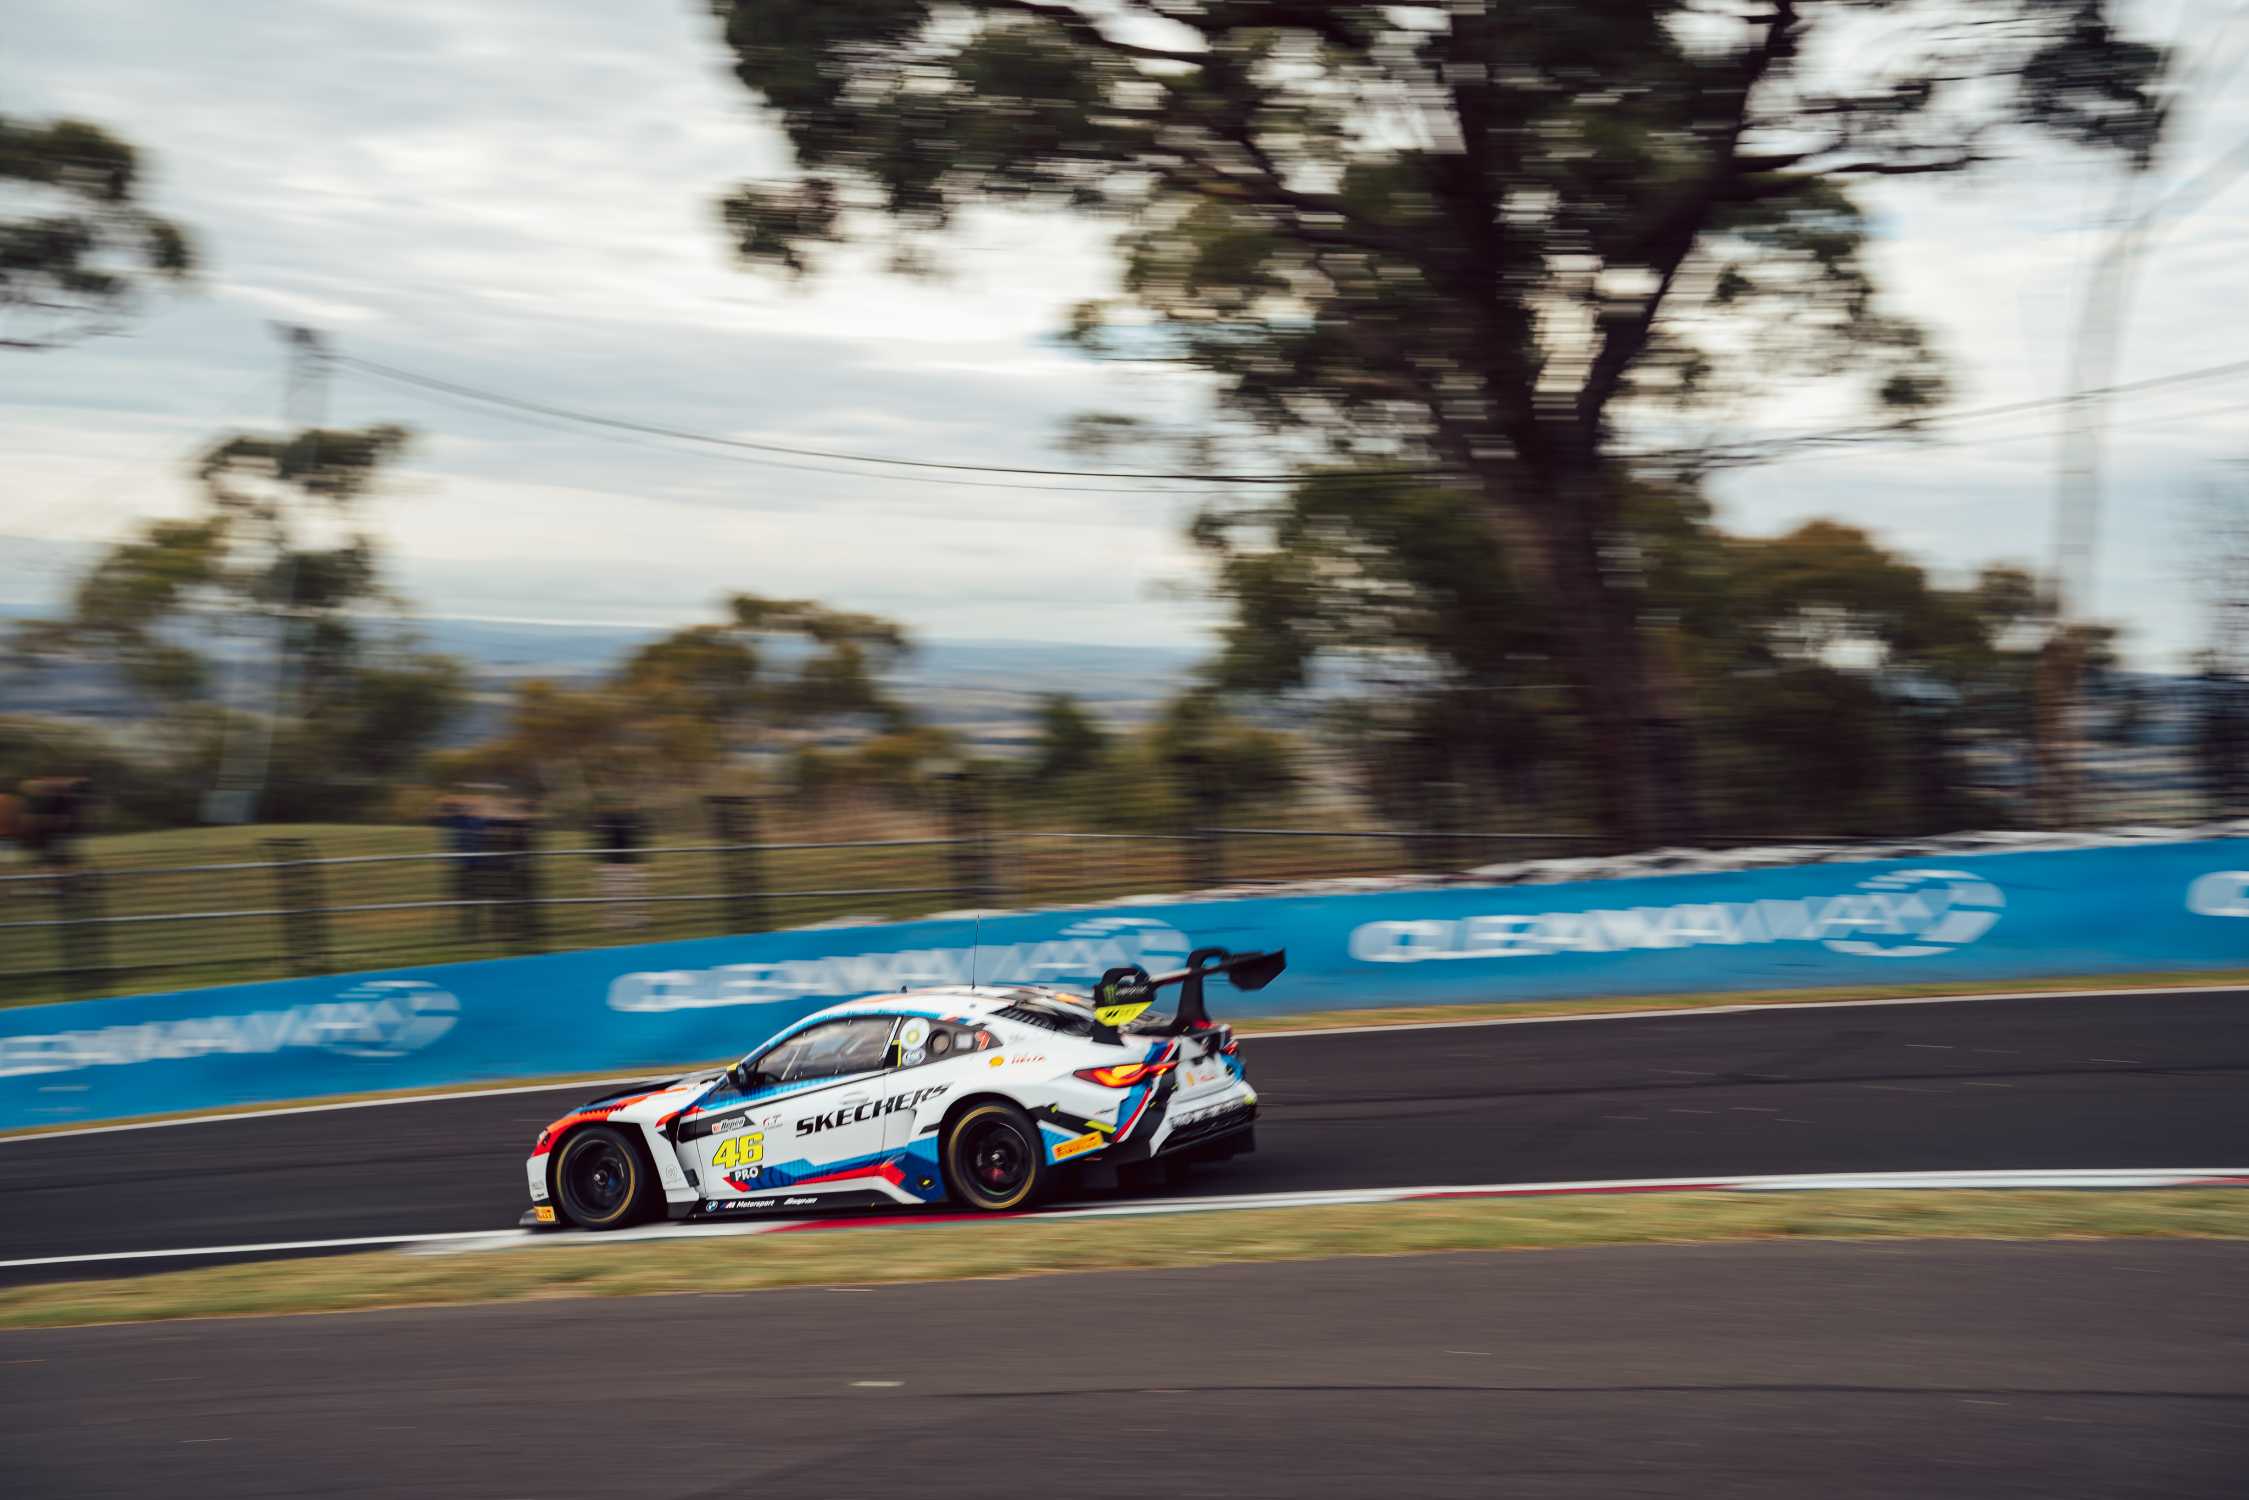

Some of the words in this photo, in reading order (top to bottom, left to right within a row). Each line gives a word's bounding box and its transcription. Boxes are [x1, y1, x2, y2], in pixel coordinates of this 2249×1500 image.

[795, 1082, 952, 1138] SKECHERS
[712, 1131, 764, 1169] 46
[734, 1166, 759, 1182] PRO
[736, 1199, 775, 1209] Motorsport
